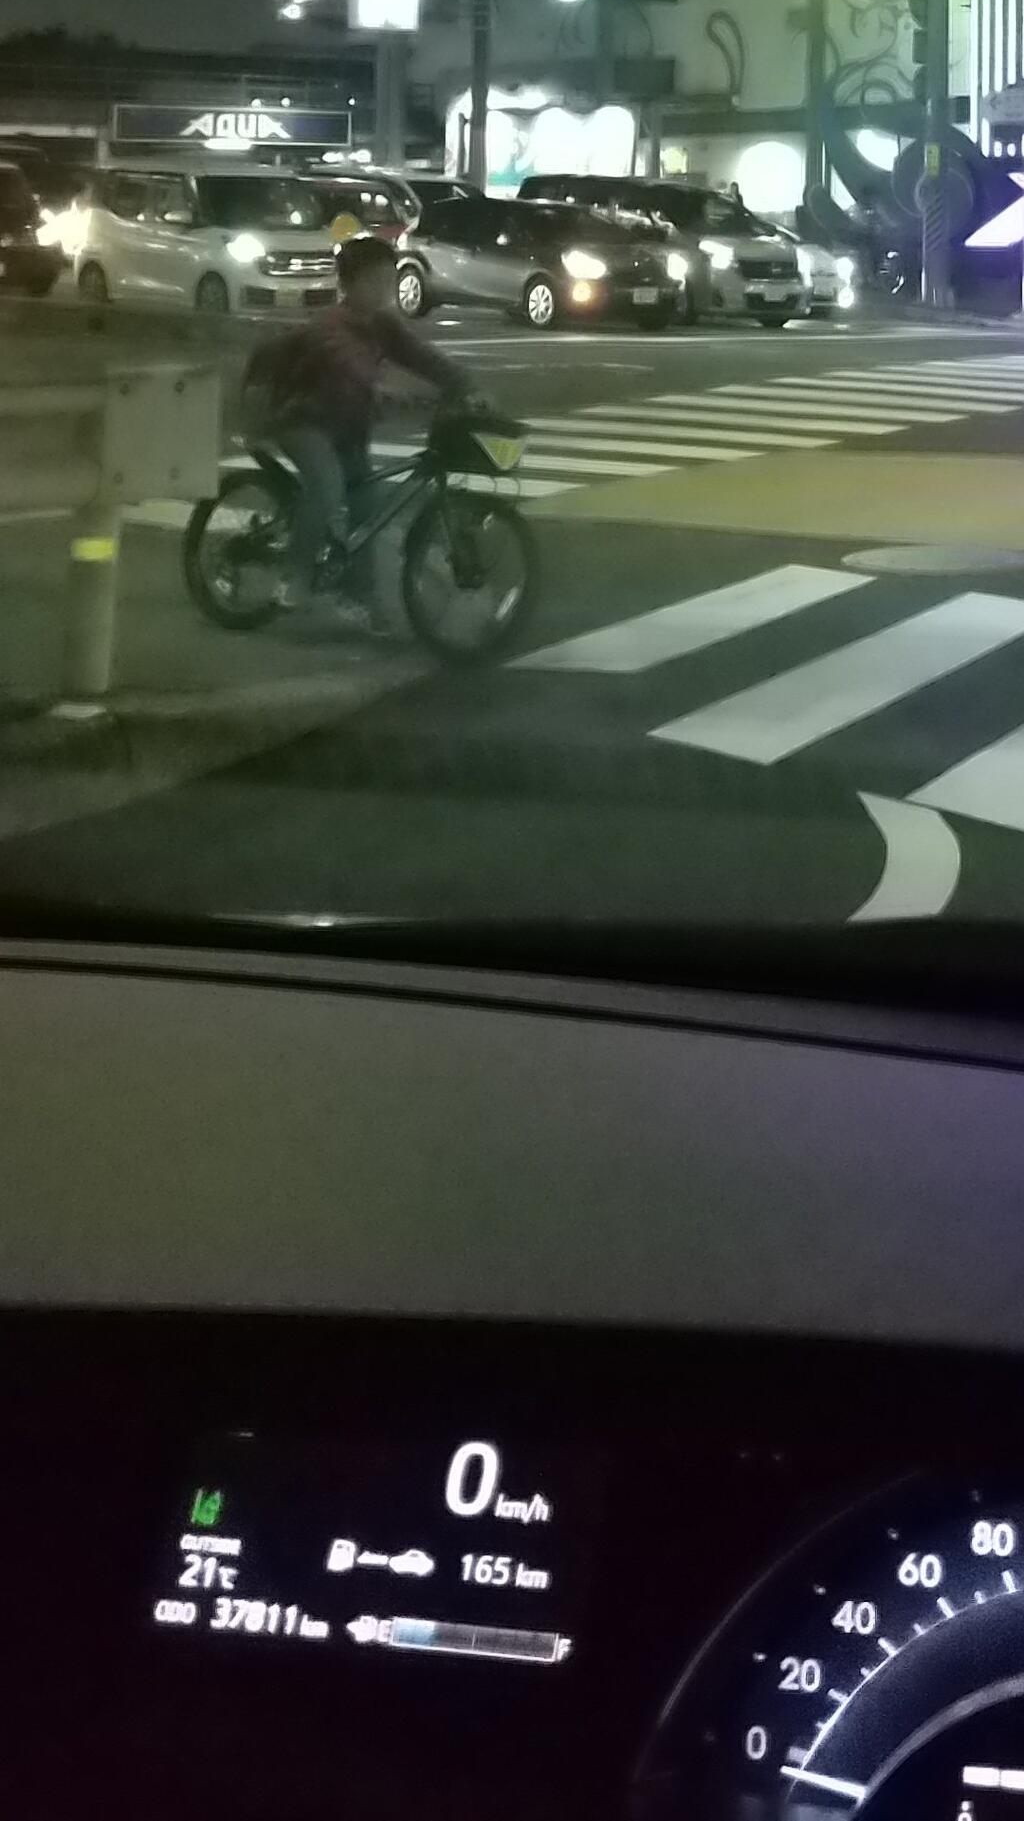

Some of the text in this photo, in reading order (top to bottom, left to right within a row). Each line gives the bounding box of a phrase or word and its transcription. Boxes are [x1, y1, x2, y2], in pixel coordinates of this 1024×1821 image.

[179, 112, 292, 140] AQUA
[445, 1442, 550, 1524] 0 km/h
[969, 1520, 1017, 1558] 80
[461, 1552, 550, 1589] 165 km
[897, 1553, 944, 1589] 60
[831, 1600, 880, 1635] 40
[778, 1656, 823, 1694] 20
[746, 1725, 768, 1760] 0
